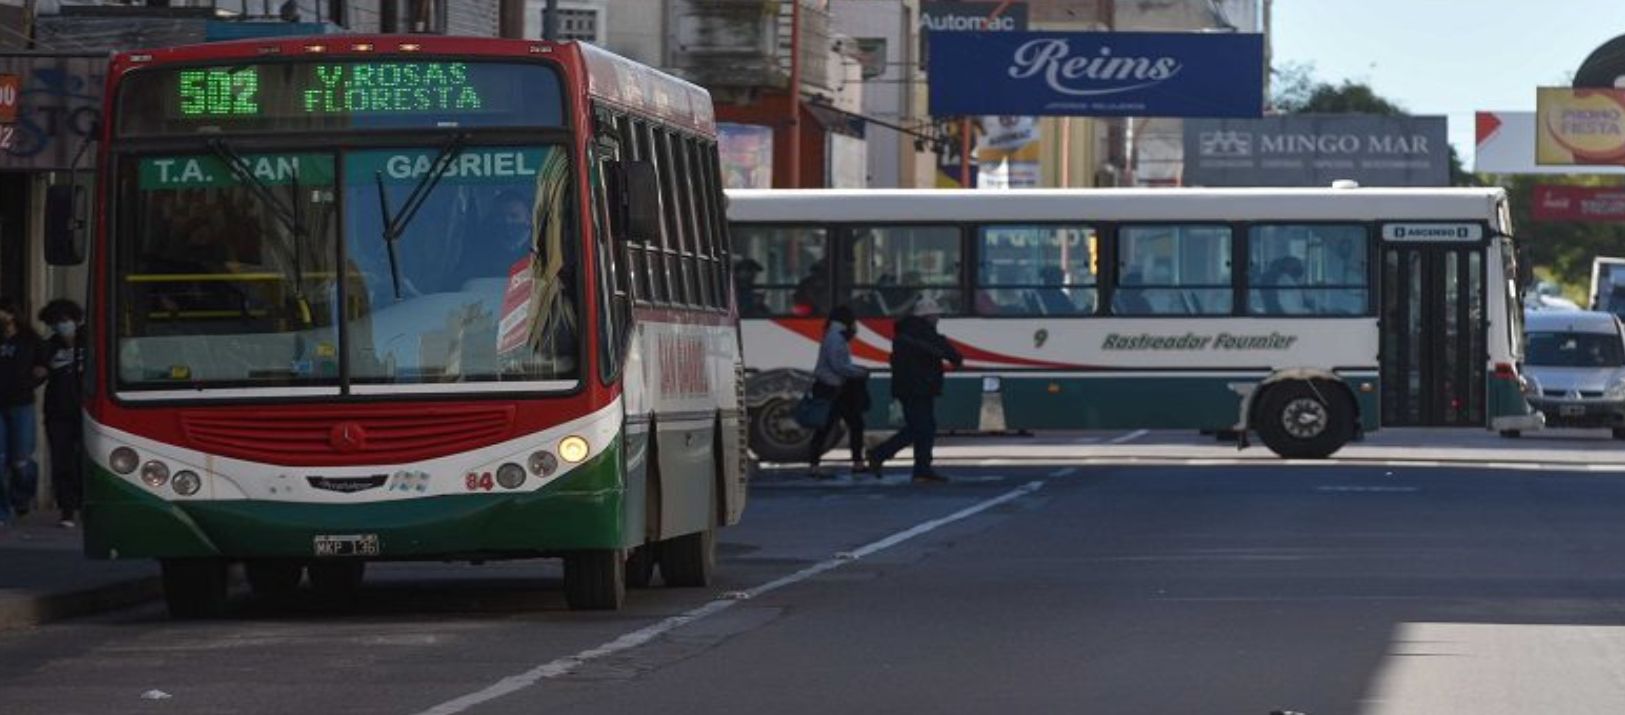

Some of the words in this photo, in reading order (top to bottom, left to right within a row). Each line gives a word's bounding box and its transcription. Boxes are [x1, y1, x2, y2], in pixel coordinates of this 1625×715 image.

[919, 13, 1015, 31] Automac
[1008, 38, 1183, 95] Reims
[180, 70, 258, 114] 502
[304, 86, 481, 112] FLORESTA
[1261, 134, 1359, 154] MINGO
[1368, 135, 1429, 154] MAR
[154, 158, 213, 183] T.A.
[1034, 329, 1048, 348] 9
[1102, 333, 1211, 350] Rastreador
[1212, 331, 1297, 350] Fournier
[465, 471, 493, 491] 84
